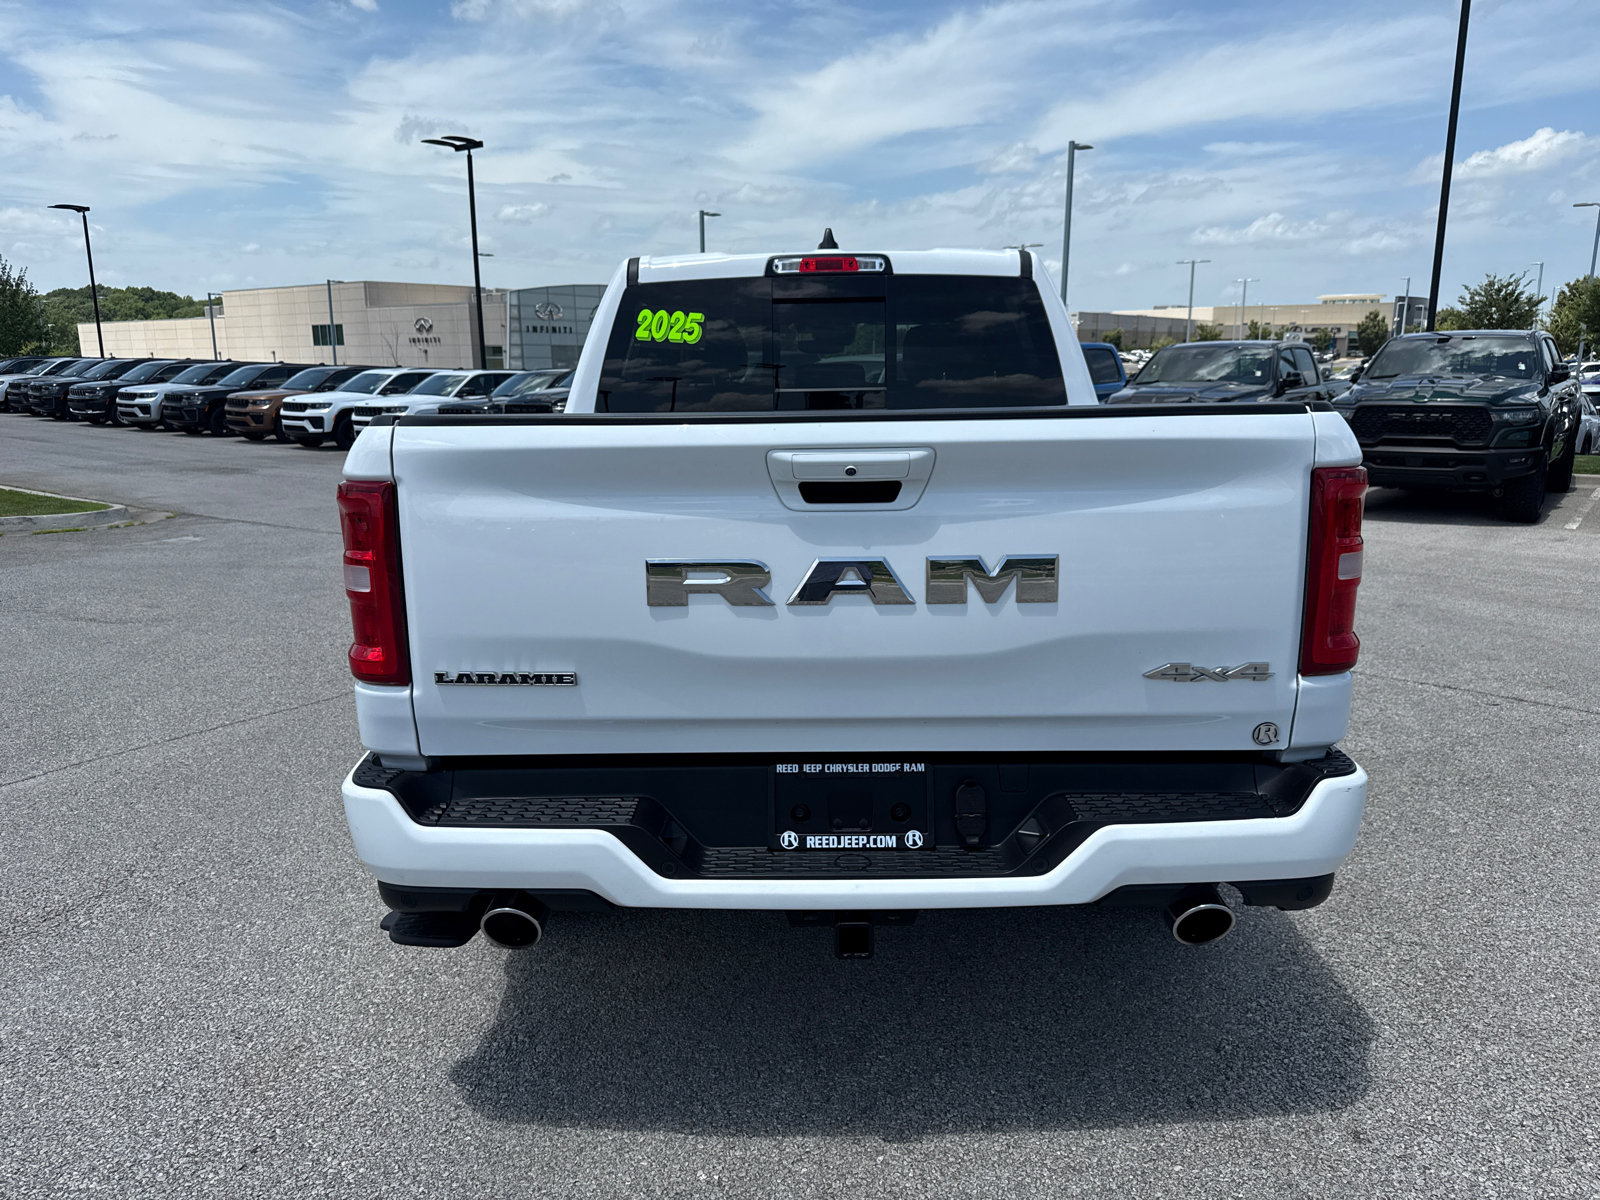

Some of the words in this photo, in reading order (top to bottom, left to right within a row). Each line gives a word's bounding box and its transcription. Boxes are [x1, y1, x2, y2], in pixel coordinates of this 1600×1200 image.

[526, 325, 572, 334] INFINITI
[635, 309, 705, 344] 2025
[645, 554, 1059, 606] RAM
[434, 671, 577, 686] LARAMIE
[776, 763, 799, 773] REED
[802, 763, 822, 773] JEEP
[824, 763, 870, 773] CHRYSLER
[872, 763, 901, 772] DODGE
[903, 763, 925, 772] RAM
[806, 835, 897, 848] REEDJEEP.COM
